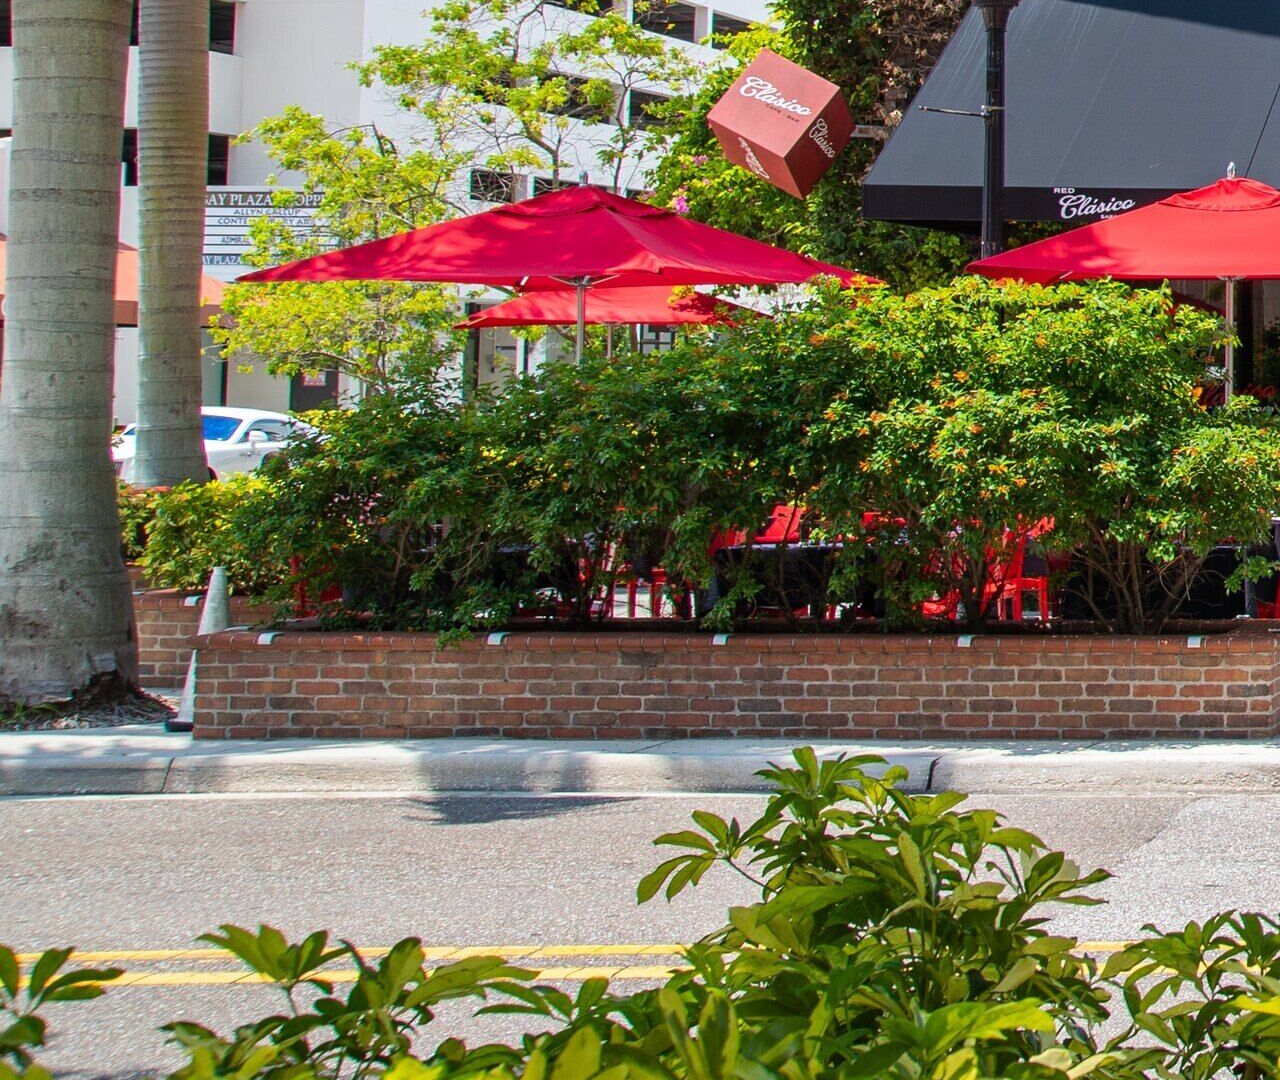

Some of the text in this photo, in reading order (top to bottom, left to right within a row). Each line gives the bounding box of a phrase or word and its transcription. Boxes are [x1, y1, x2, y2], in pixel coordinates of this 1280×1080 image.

[739, 76, 812, 116] Clásico
[808, 118, 836, 158] Clásico
[230, 194, 274, 206] PLAZA
[1059, 194, 1136, 219] Clásico
